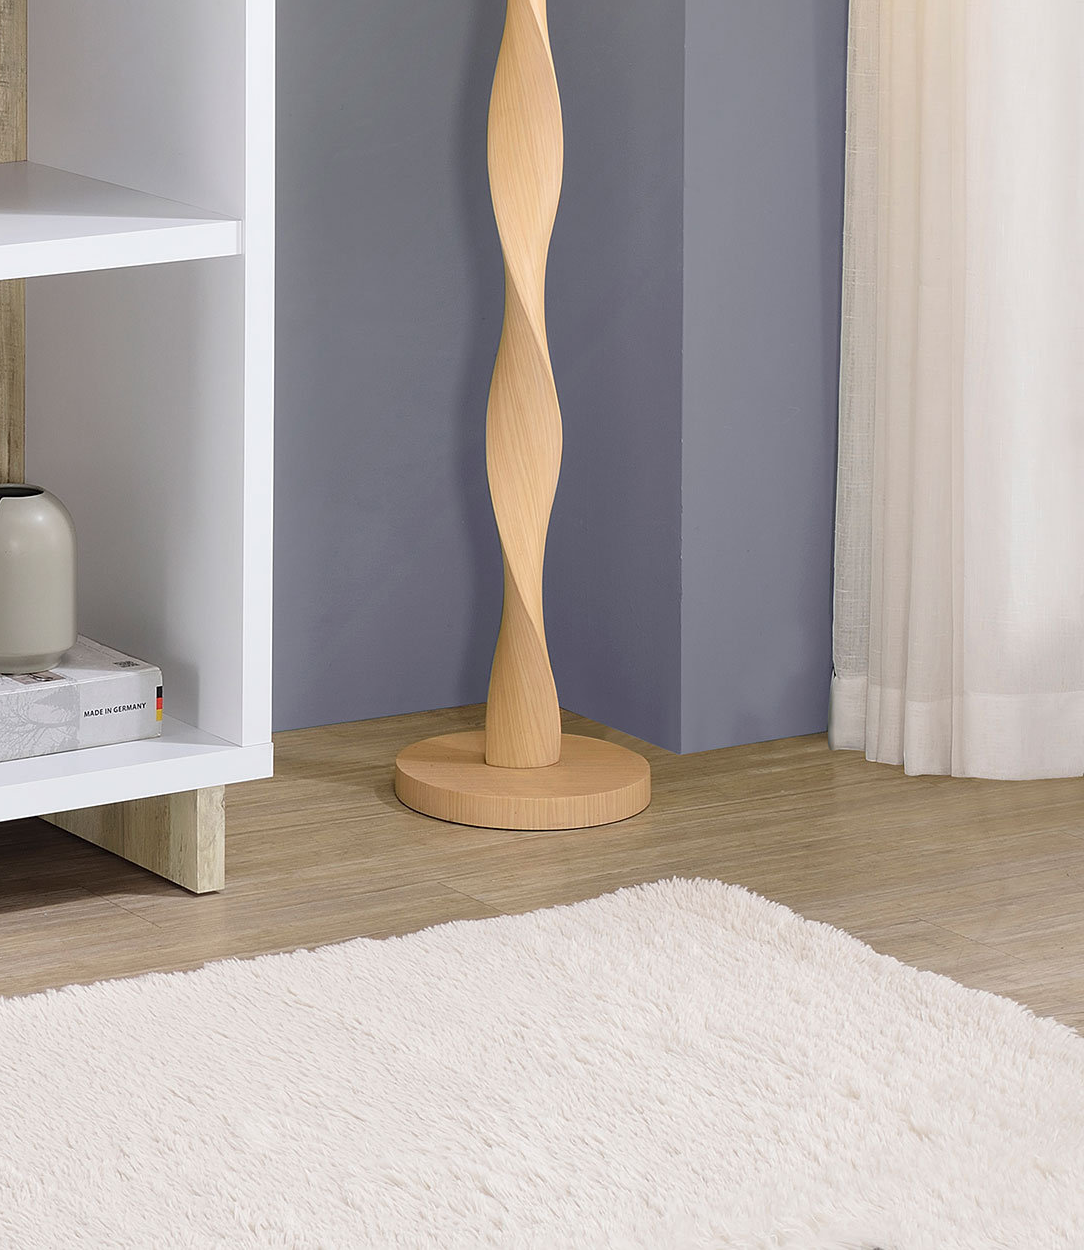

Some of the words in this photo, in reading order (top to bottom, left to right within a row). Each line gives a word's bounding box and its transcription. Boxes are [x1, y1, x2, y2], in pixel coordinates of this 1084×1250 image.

[83, 708, 103, 718] MADE
[104, 707, 113, 715] IN
[113, 702, 147, 713] GERMANY
